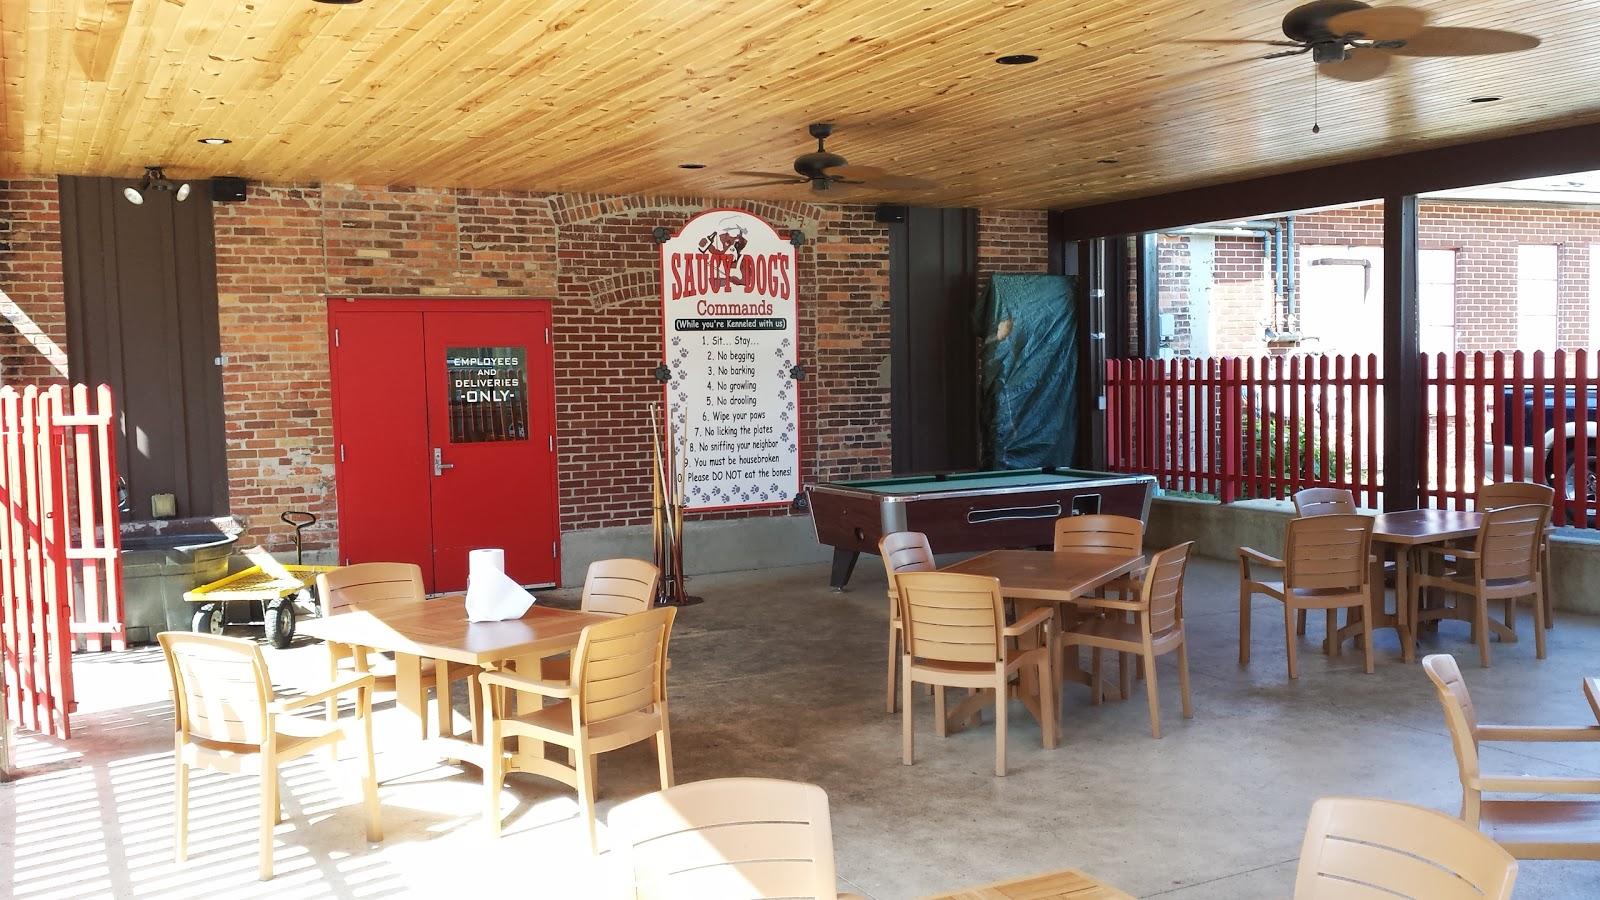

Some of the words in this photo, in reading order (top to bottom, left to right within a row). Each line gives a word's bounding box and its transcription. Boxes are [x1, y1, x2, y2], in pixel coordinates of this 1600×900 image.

[671, 253, 734, 300] SAUCY
[742, 252, 790, 300] DOG'S
[697, 300, 773, 316] Commands
[676, 319, 699, 329] (While
[702, 320, 724, 330] you're
[727, 320, 757, 328] Kenneled
[759, 319, 773, 328] with
[775, 319, 786, 329] us)
[702, 336, 709, 345] 1.
[712, 336, 732, 345] Sit...
[734, 336, 759, 347] Stay...
[454, 357, 518, 366] EMPLOYEES
[707, 351, 715, 360] 2.
[717, 351, 728, 360] No
[730, 351, 755, 362] begging
[708, 366, 715, 376] 3.
[718, 366, 728, 375] No
[730, 366, 755, 377] barking
[455, 379, 519, 388] DELIVERIES
[707, 381, 714, 391] 4.
[717, 381, 727, 390] No
[730, 381, 757, 392] growling
[706, 397, 714, 406] 5.
[717, 396, 727, 405] No
[730, 396, 757, 407] drooling
[702, 412, 709, 421] 6.
[712, 411, 730, 422] Wipe
[733, 412, 747, 423] your
[750, 411, 766, 422] paws
[694, 428, 702, 437] 7.
[705, 427, 714, 436] No
[717, 426, 737, 437] licking
[740, 425, 751, 435] the
[753, 425, 773, 436] plates
[689, 443, 696, 452] 8.
[699, 442, 708, 452] No
[711, 441, 734, 452] sniffing
[736, 442, 750, 453] your
[752, 440, 778, 451] neighbor
[694, 458, 707, 467] You
[709, 457, 725, 466] must
[728, 456, 736, 465] be
[739, 455, 780, 464] housebroken
[688, 473, 709, 482] Please
[712, 471, 723, 481] DO
[725, 470, 742, 480] NOT
[744, 469, 756, 478] eat
[758, 468, 769, 478] the
[772, 467, 792, 477] bones!
